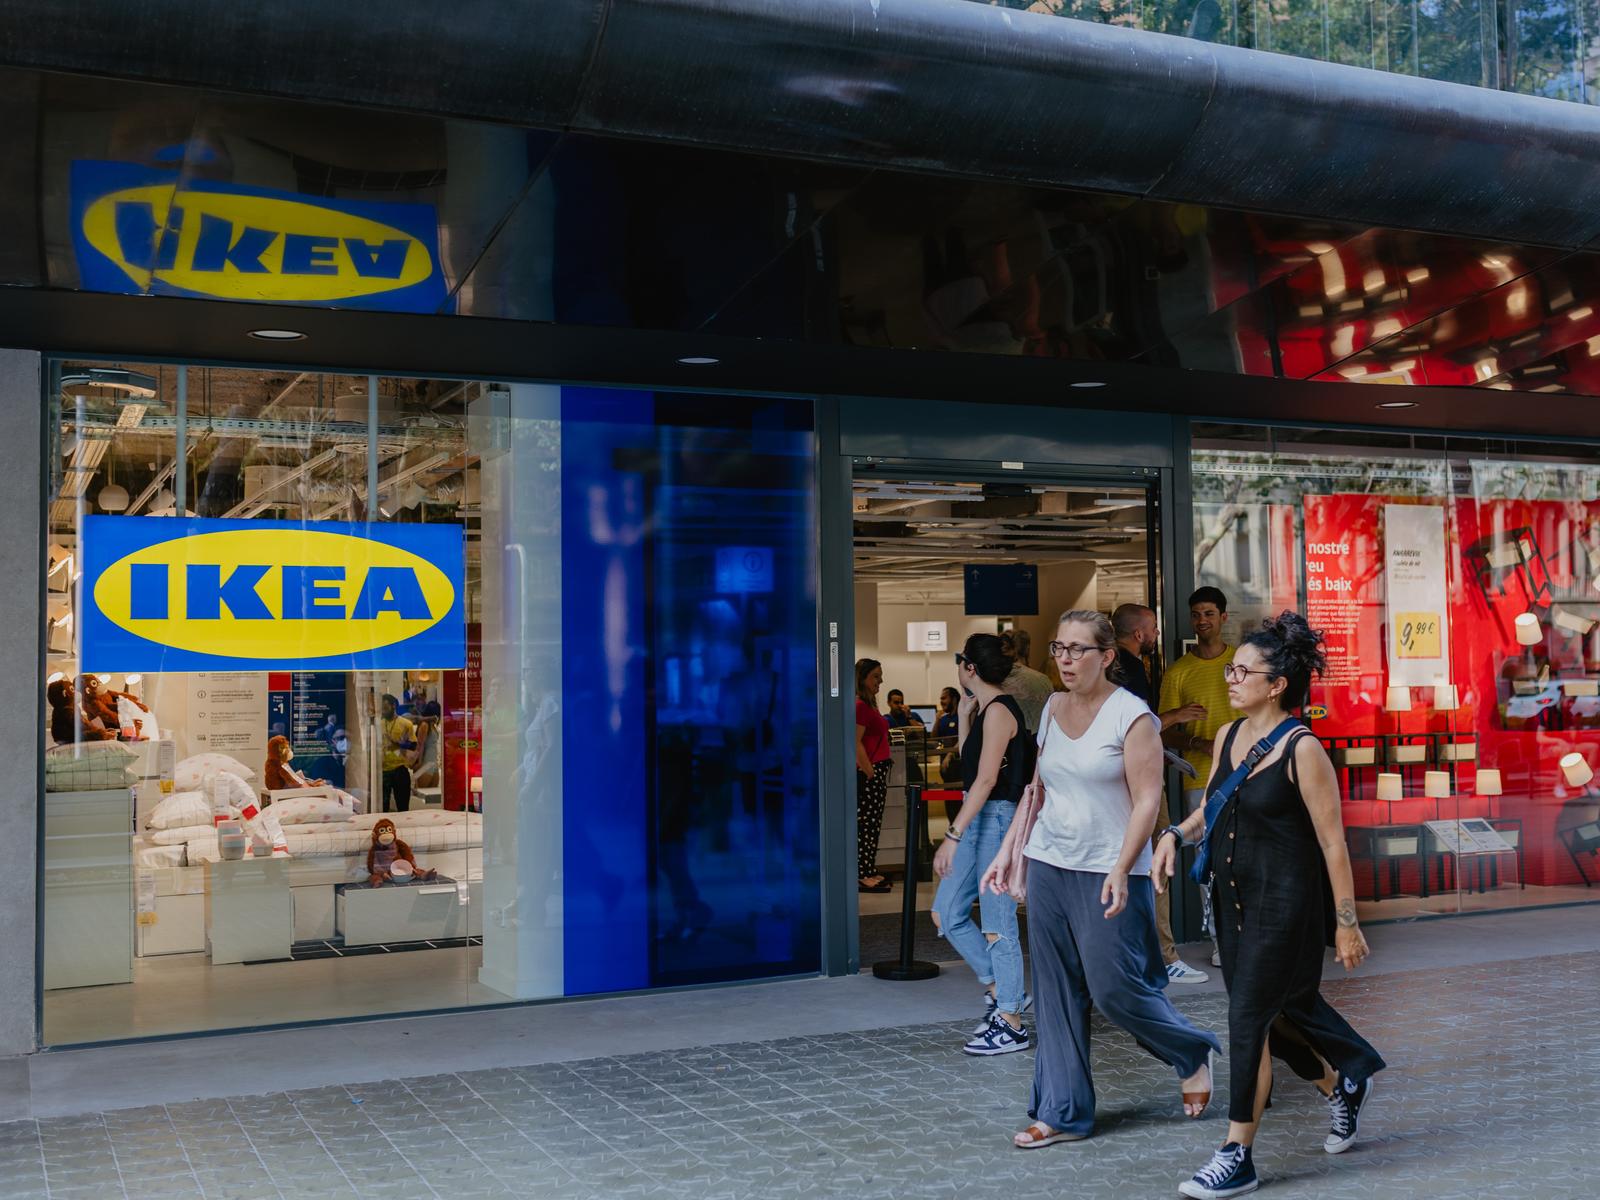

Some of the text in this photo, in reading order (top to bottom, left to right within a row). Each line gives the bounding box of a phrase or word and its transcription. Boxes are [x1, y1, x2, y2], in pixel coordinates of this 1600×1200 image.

[1308, 542, 1350, 555] nostre
[1306, 561, 1325, 573] eu
[1308, 576, 1352, 592] és baix
[131, 564, 432, 620] IKEA
